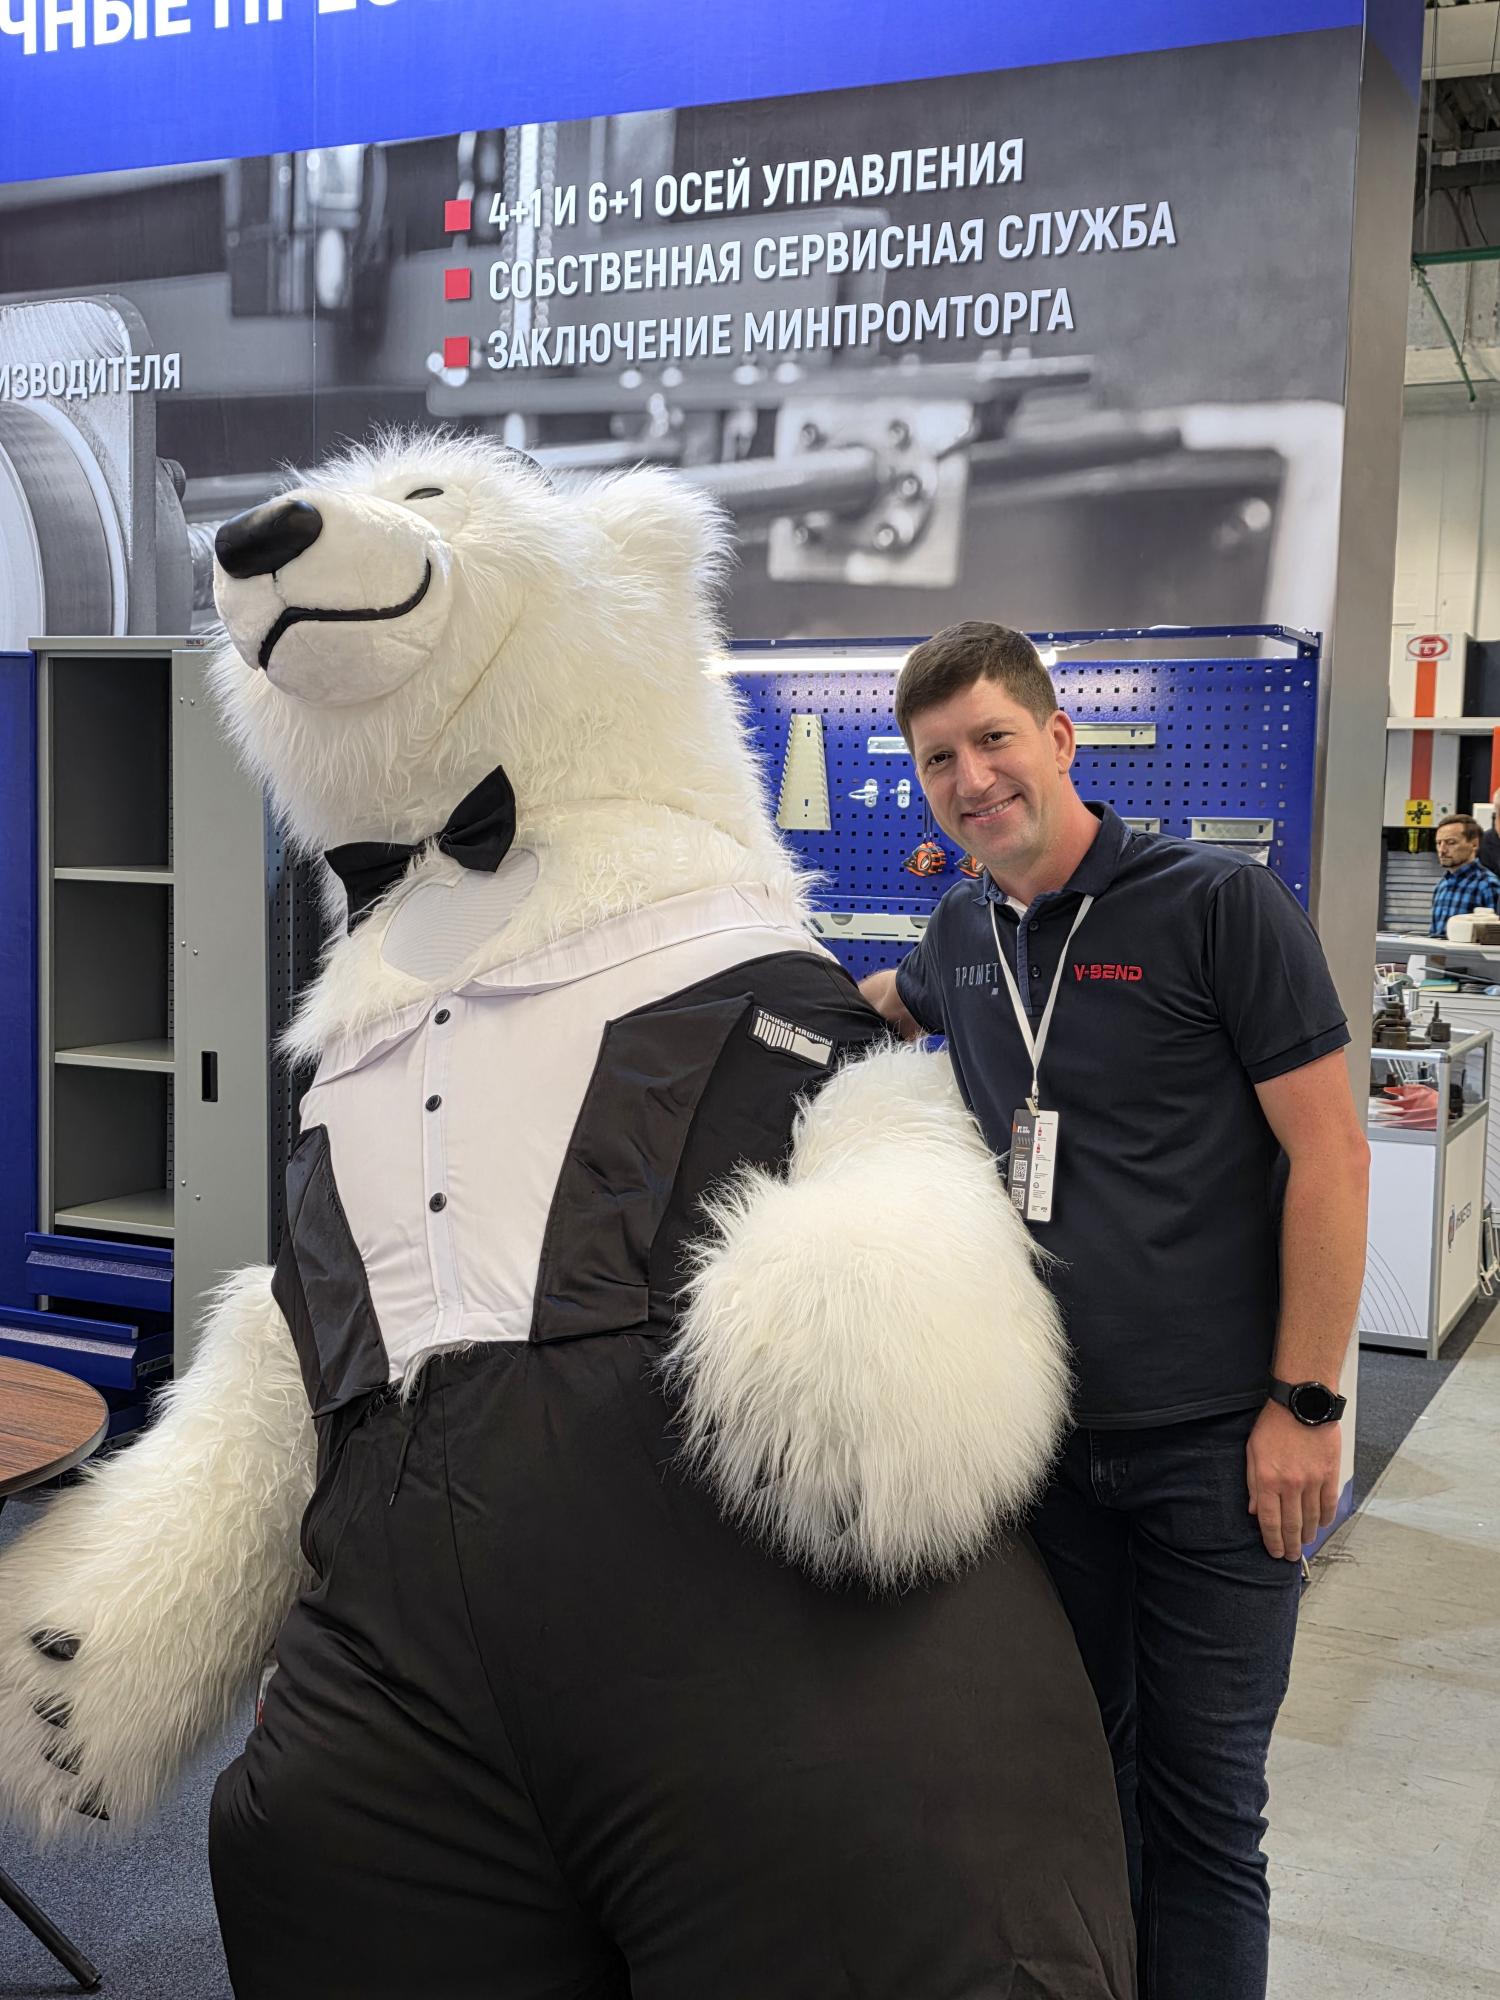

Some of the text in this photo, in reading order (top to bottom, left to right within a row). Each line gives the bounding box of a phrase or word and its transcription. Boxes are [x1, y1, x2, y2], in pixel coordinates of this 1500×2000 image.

[488, 137, 1025, 232] 4+1 И 6+1 ОСЕЙ УПРАВЛЕНИЯ
[489, 200, 1177, 301] СОБСТВЕННАЯ СЕРВИСНАЯ СЛУЖБА
[487, 287, 1075, 370] ЗАКЛЮЧЕНИЕ МИНПРОМТОРГА
[1073, 963, 1144, 982] V-BEND
[758, 1009, 833, 1047] ТОЧНЫЕ МАШИНЫ
